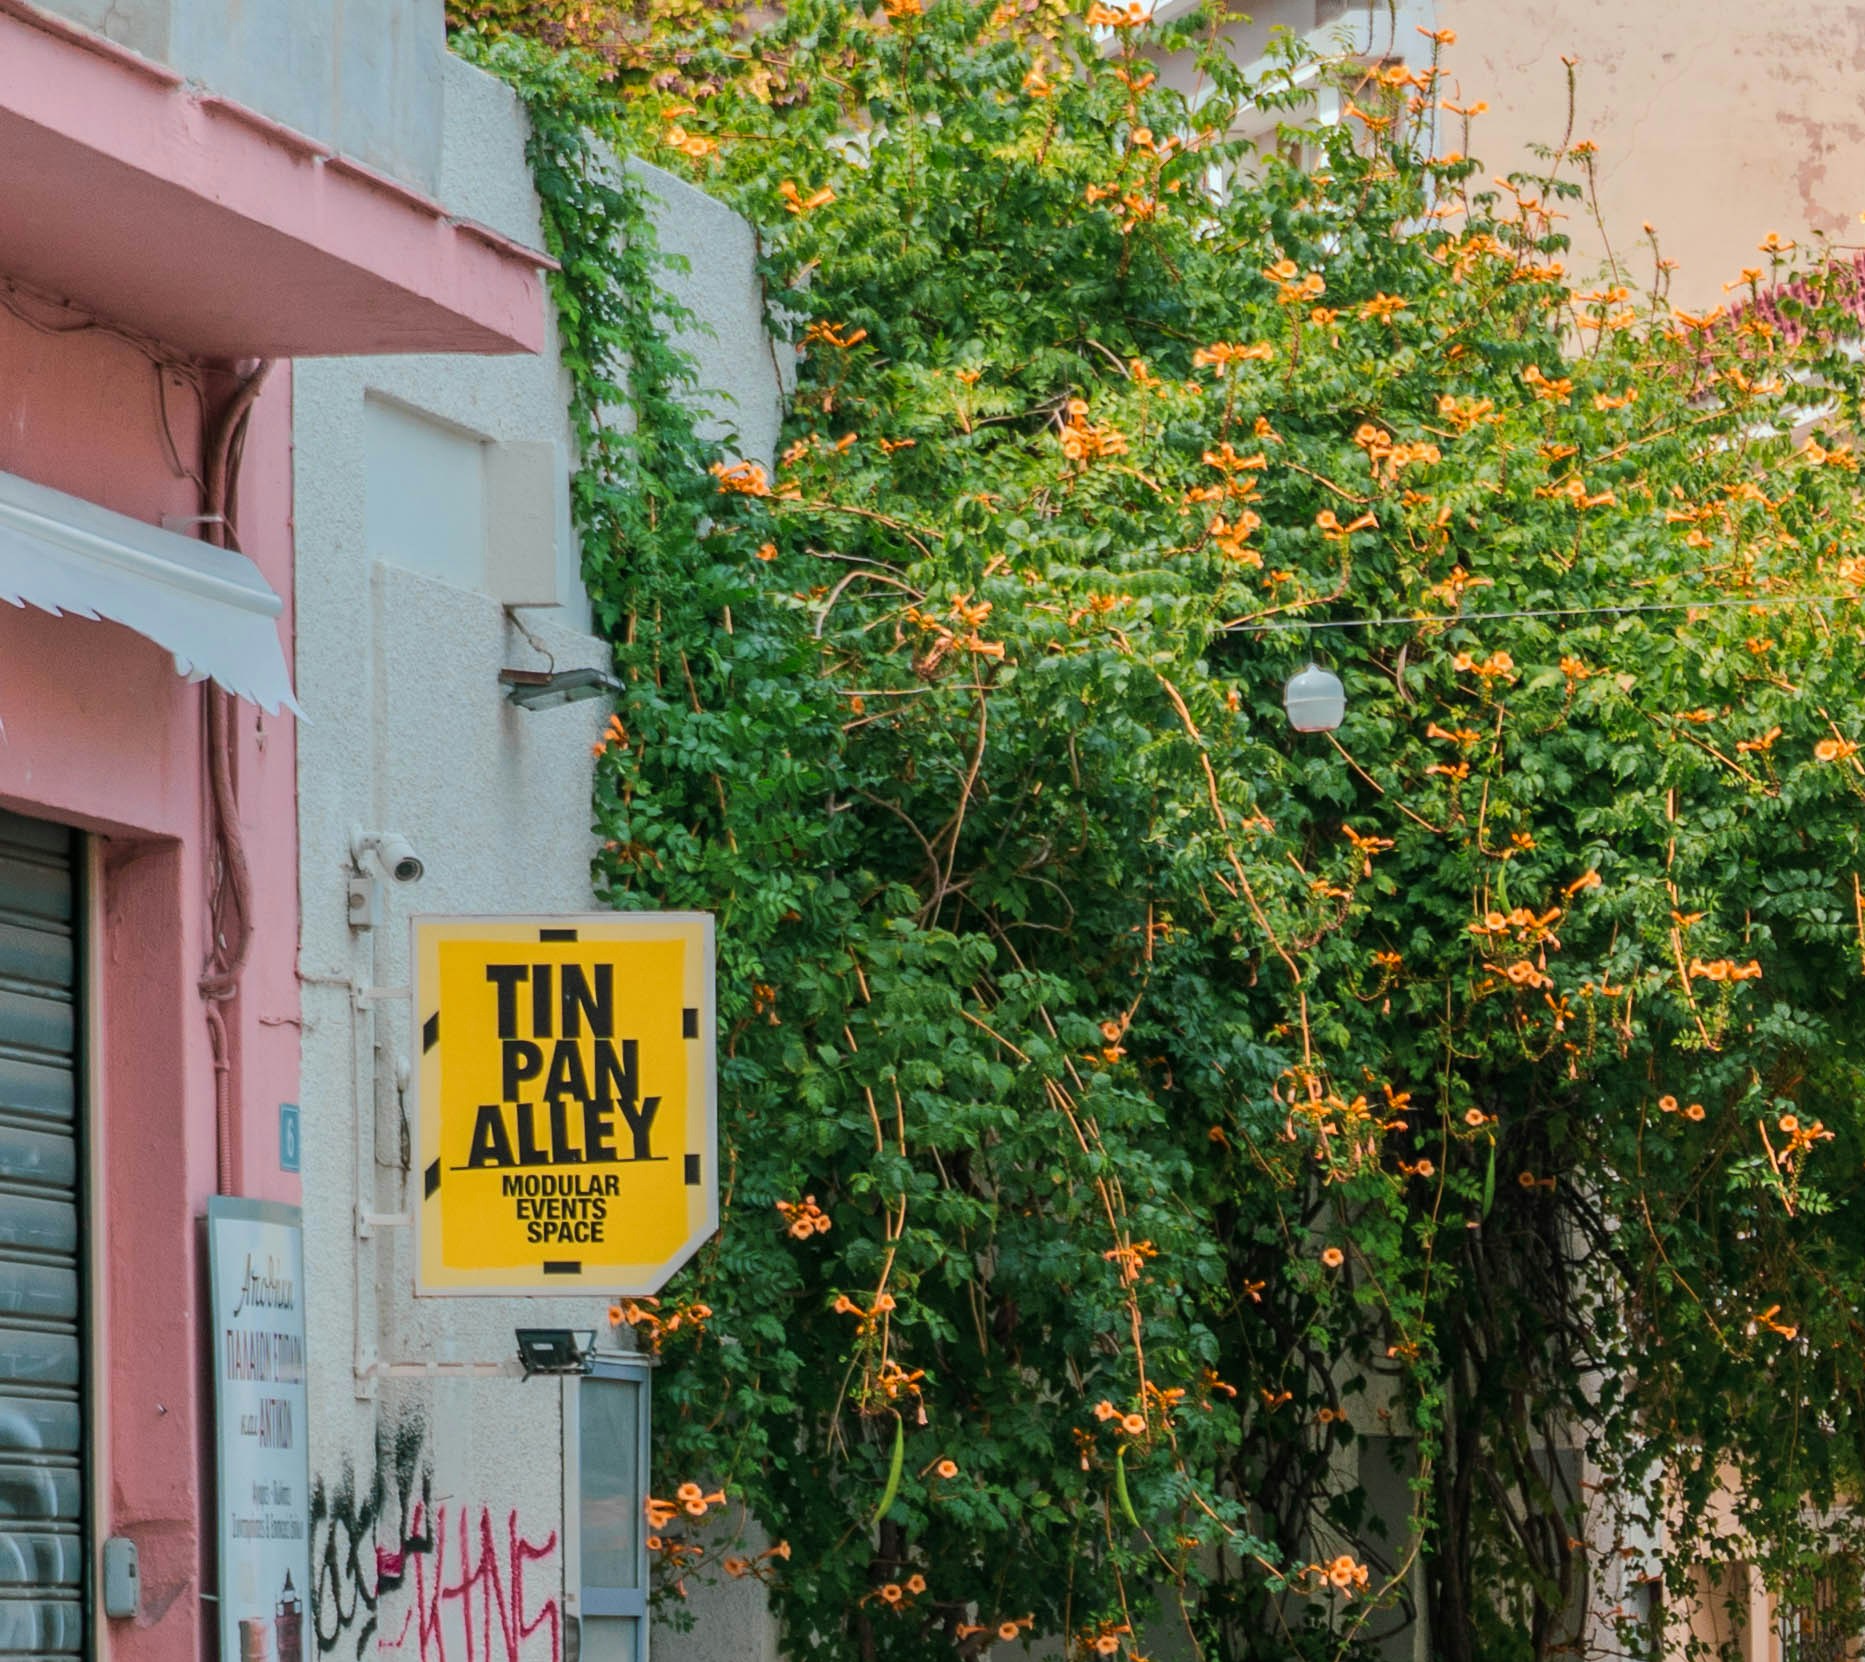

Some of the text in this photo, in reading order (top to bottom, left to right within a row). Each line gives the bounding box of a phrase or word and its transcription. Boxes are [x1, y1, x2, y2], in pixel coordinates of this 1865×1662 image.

[486, 963, 614, 1039] TIN
[502, 1038, 639, 1102] PAN
[287, 1117, 295, 1158] 6
[468, 1096, 663, 1168] ALLEY
[502, 1174, 620, 1197] MODULAR
[516, 1198, 608, 1220] EVENTS
[527, 1221, 604, 1243] SPACE
